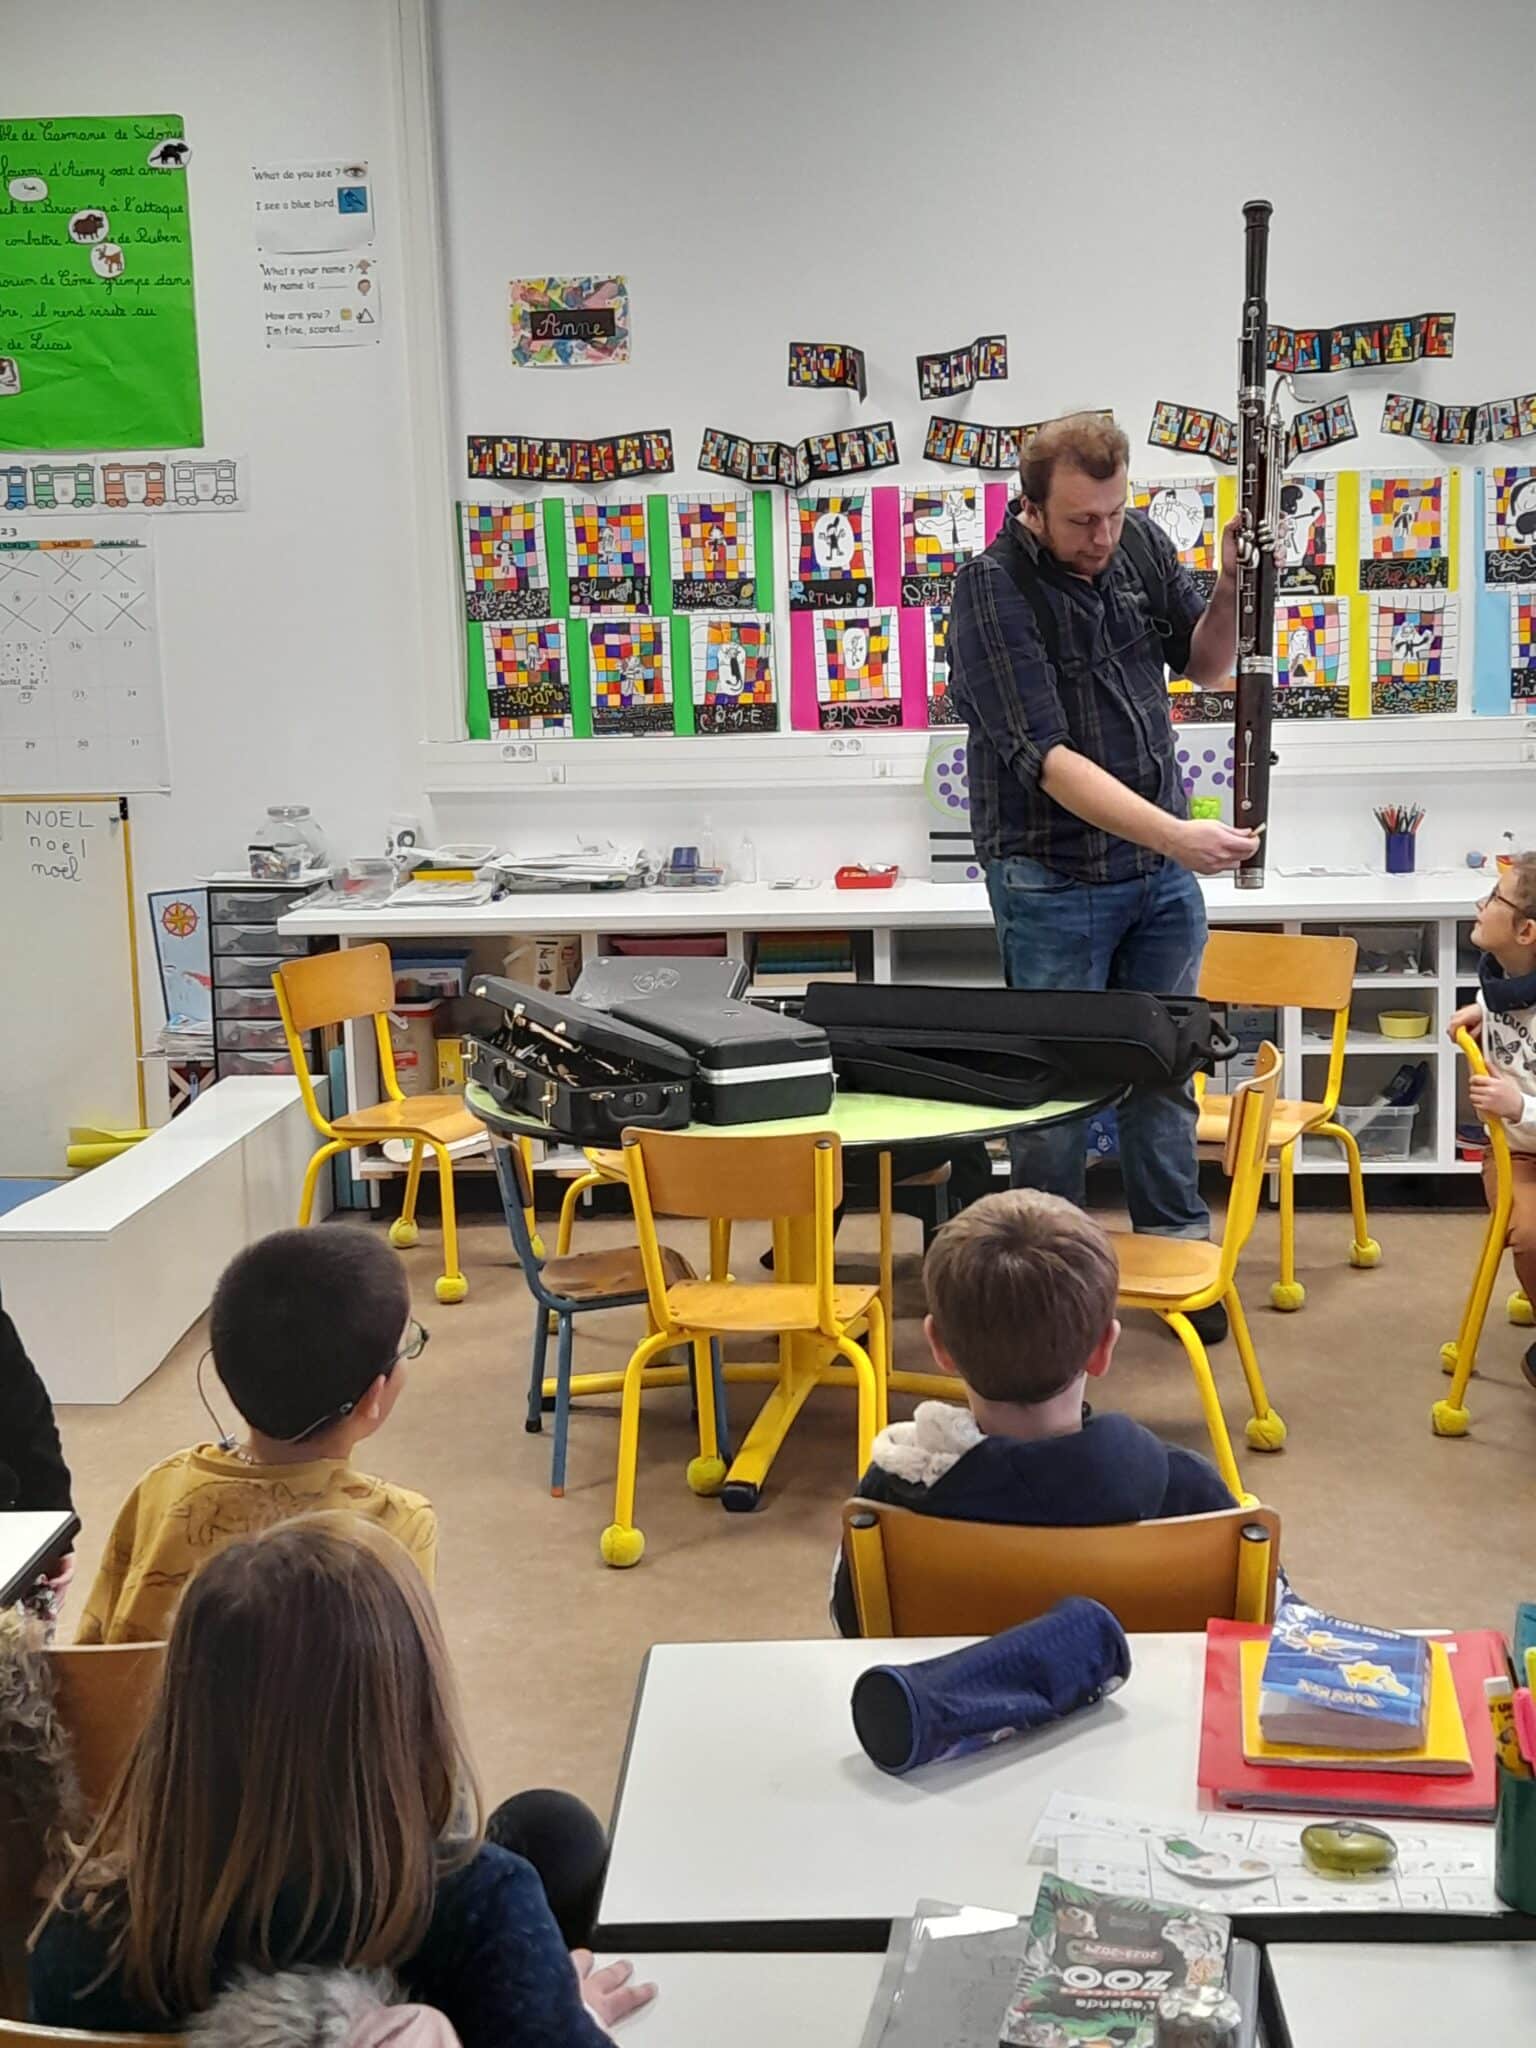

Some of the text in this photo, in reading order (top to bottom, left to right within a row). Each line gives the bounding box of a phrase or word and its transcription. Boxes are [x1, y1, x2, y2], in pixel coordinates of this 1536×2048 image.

[22, 129, 36, 141] de
[114, 128, 129, 140] de
[254, 167, 341, 182] What do you see ?
[256, 200, 261, 211] I
[264, 201, 281, 210] see
[291, 198, 312, 210] blue
[297, 265, 319, 277] your
[321, 265, 346, 275] name
[348, 263, 355, 273] ?
[263, 280, 316, 293] My name is
[265, 311, 286, 321] How
[306, 311, 324, 321] you
[325, 309, 331, 319] ?
[536, 312, 605, 337] Anne
[25, 810, 95, 828] NOEL
[1062, 1965, 1174, 1991] ZOO
[1074, 1998, 1157, 2011] L'agenda
